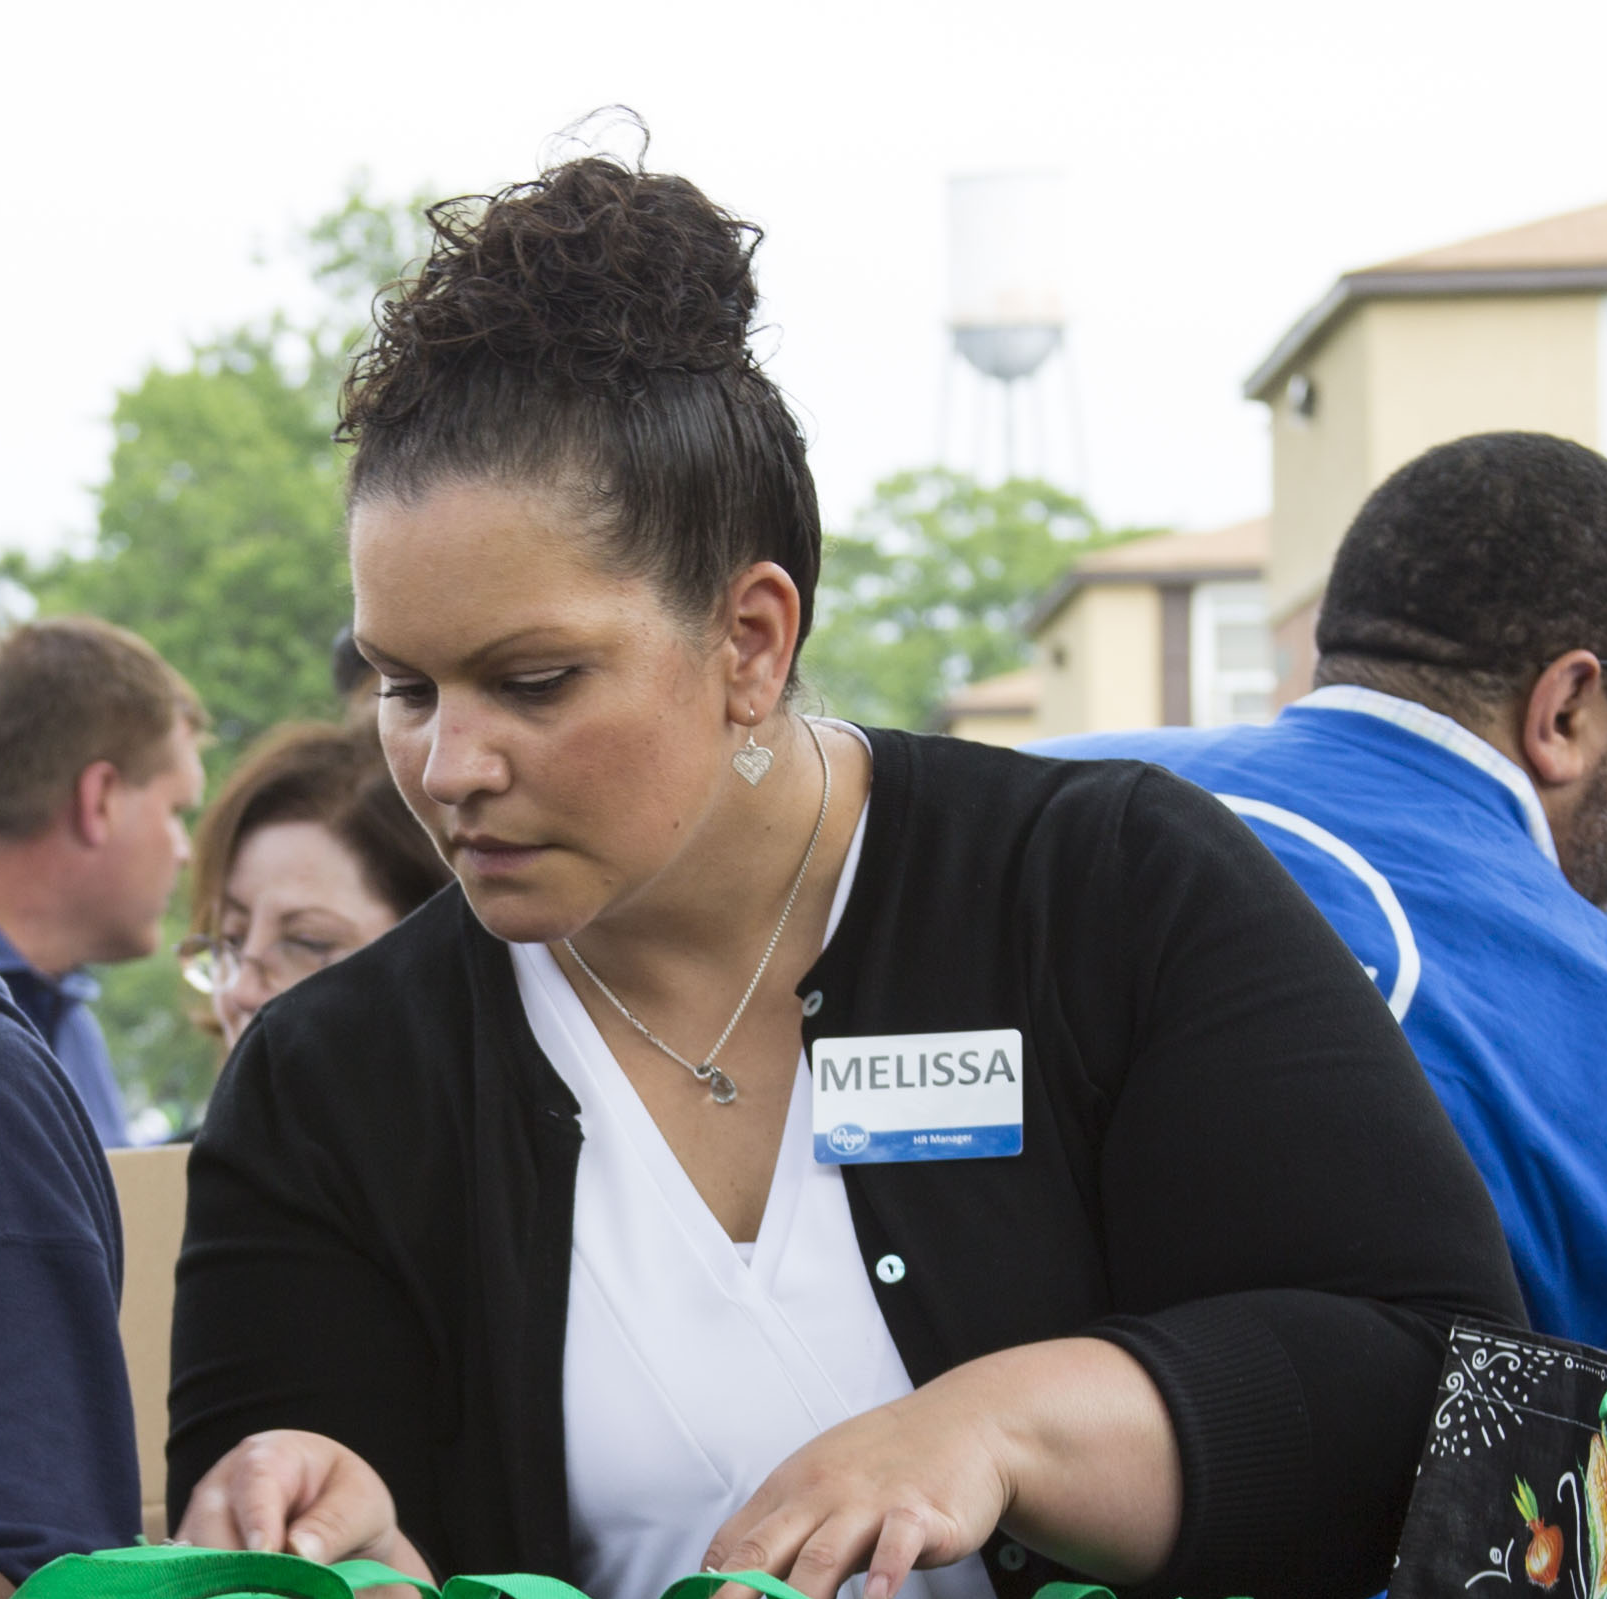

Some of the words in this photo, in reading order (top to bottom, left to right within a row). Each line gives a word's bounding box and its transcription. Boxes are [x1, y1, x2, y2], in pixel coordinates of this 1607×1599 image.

[820, 1049, 1016, 1092] MELISSA
[913, 1135, 928, 1145] HR
[929, 1133, 973, 1147] Manager
